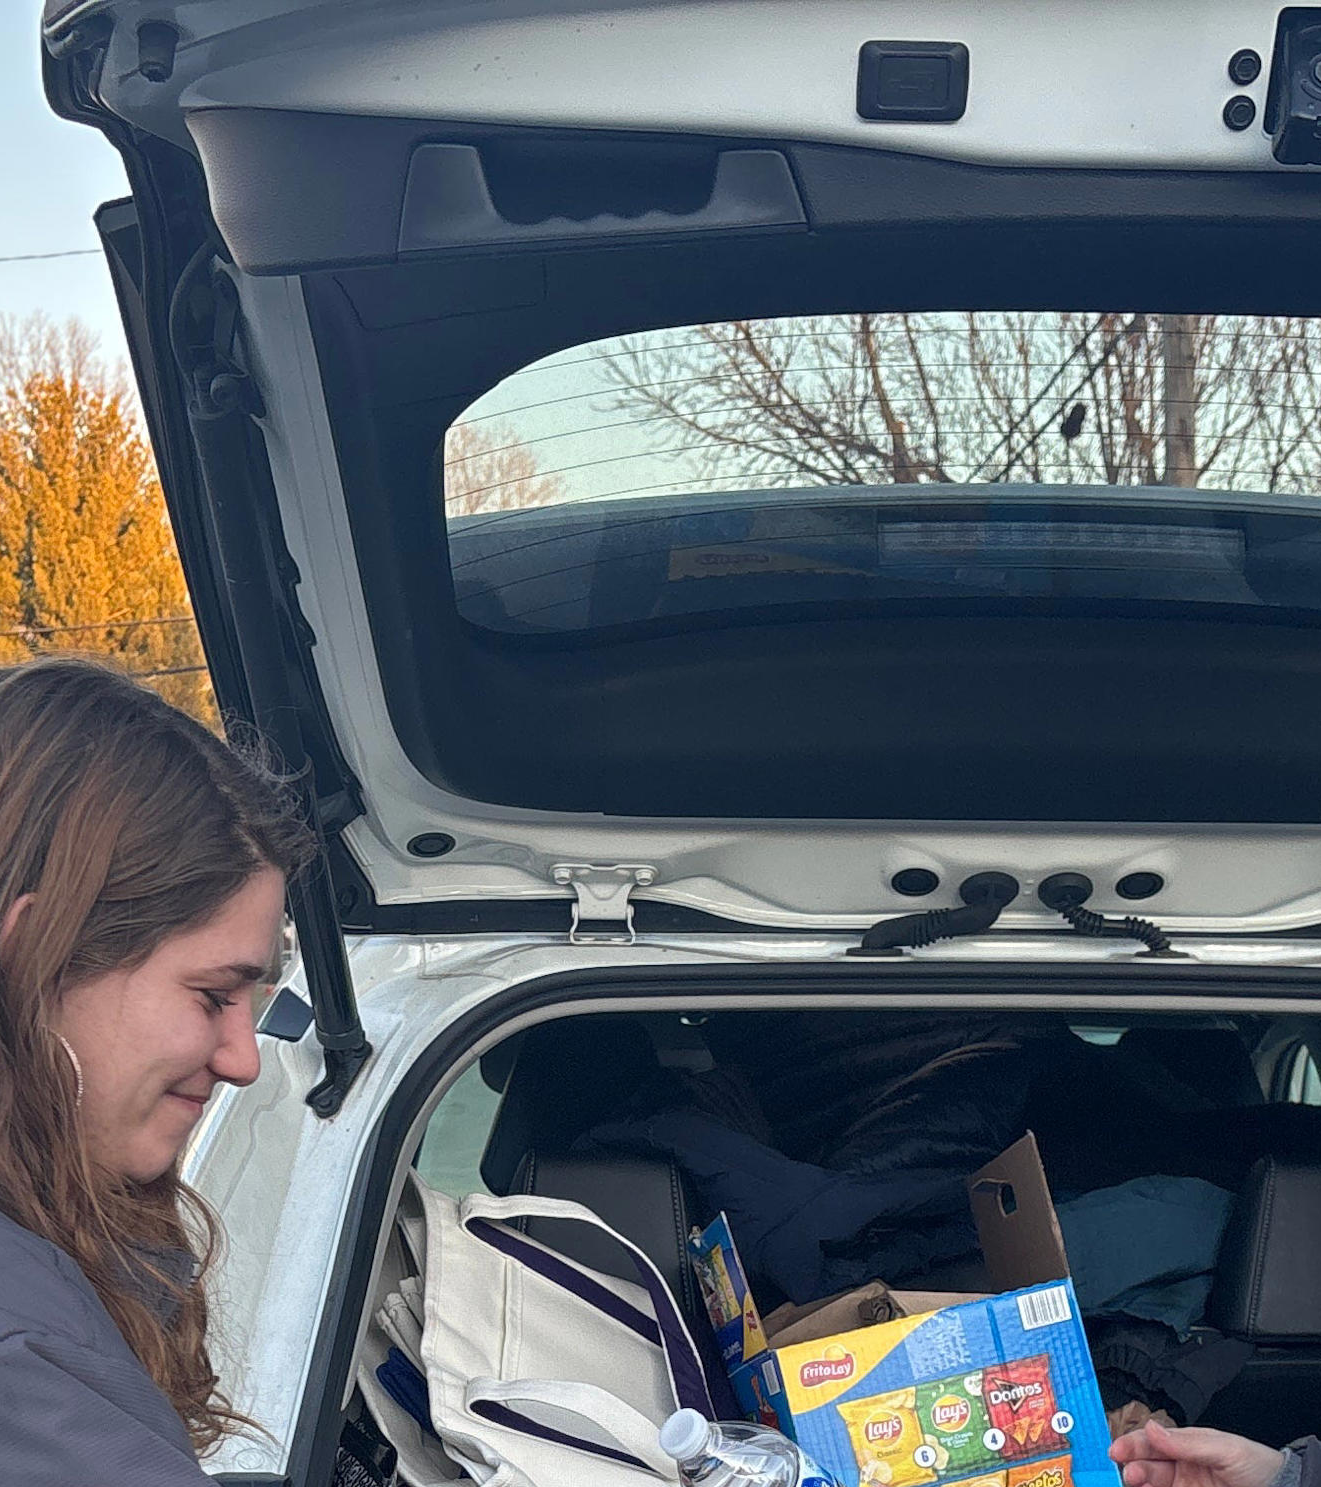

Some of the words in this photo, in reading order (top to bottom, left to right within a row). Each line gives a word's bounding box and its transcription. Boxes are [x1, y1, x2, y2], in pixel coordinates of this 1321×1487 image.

[990, 1382, 1042, 1405] Doritos
[935, 1402, 968, 1423] Lay's
[1056, 1415, 1069, 1430] 10
[868, 1418, 901, 1440] Lay's
